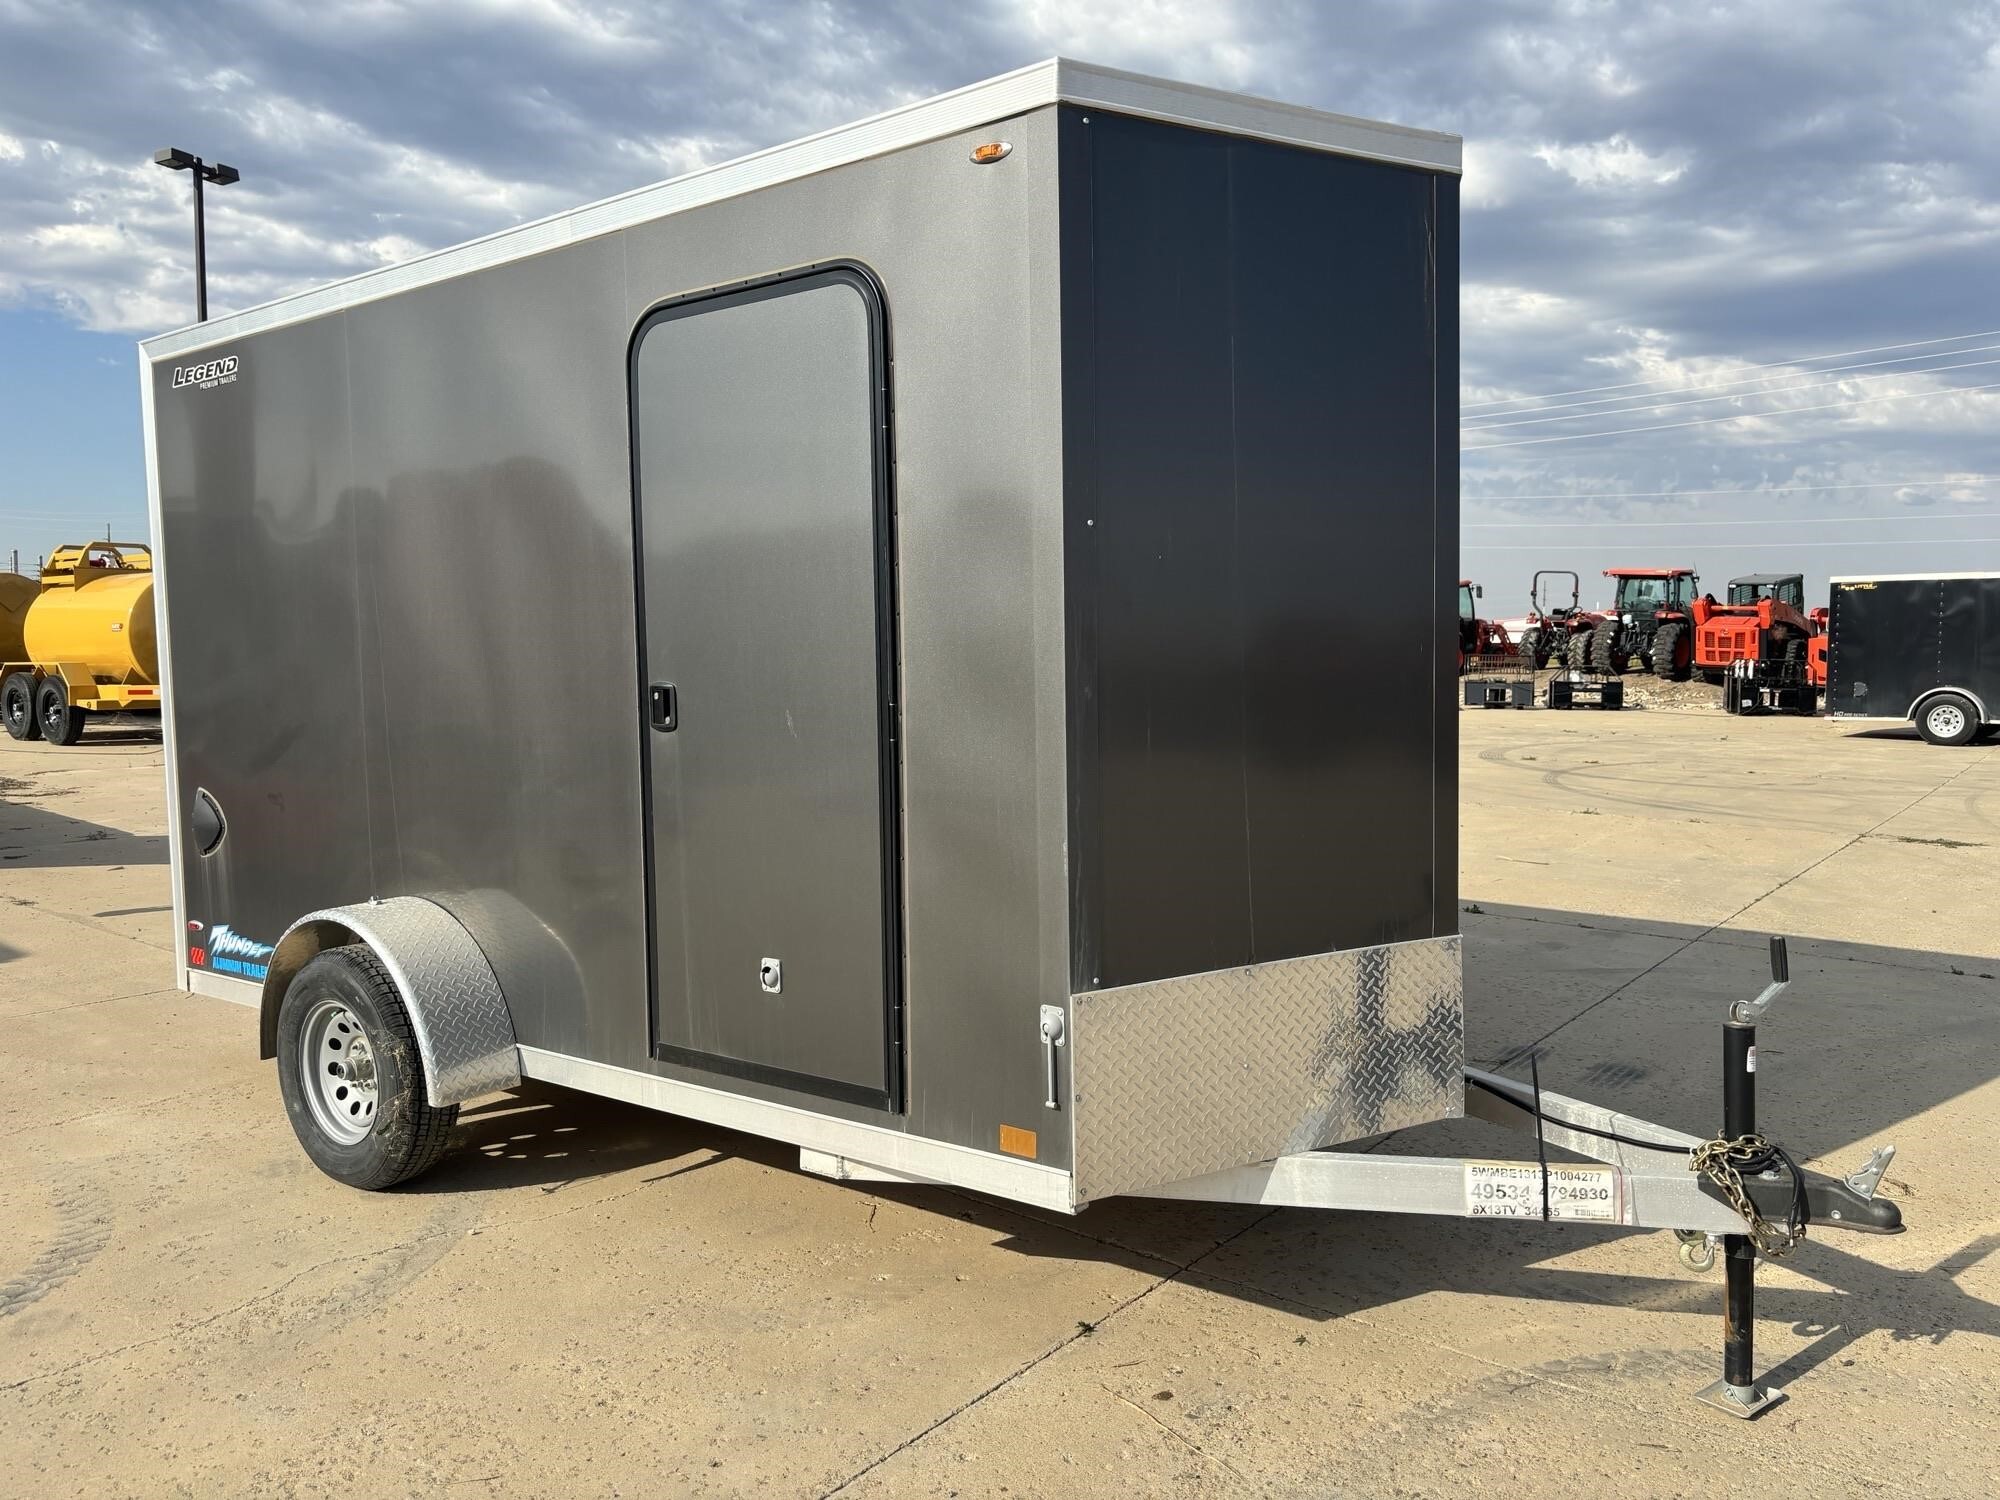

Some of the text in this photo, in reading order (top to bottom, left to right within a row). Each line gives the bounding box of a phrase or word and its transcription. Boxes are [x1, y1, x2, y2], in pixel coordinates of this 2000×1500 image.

[172, 355, 239, 388] LEGEND
[208, 924, 275, 958] THUNDER
[1471, 1183, 1530, 1200] 49534
[1472, 1204, 1517, 1215] 6X13TV
